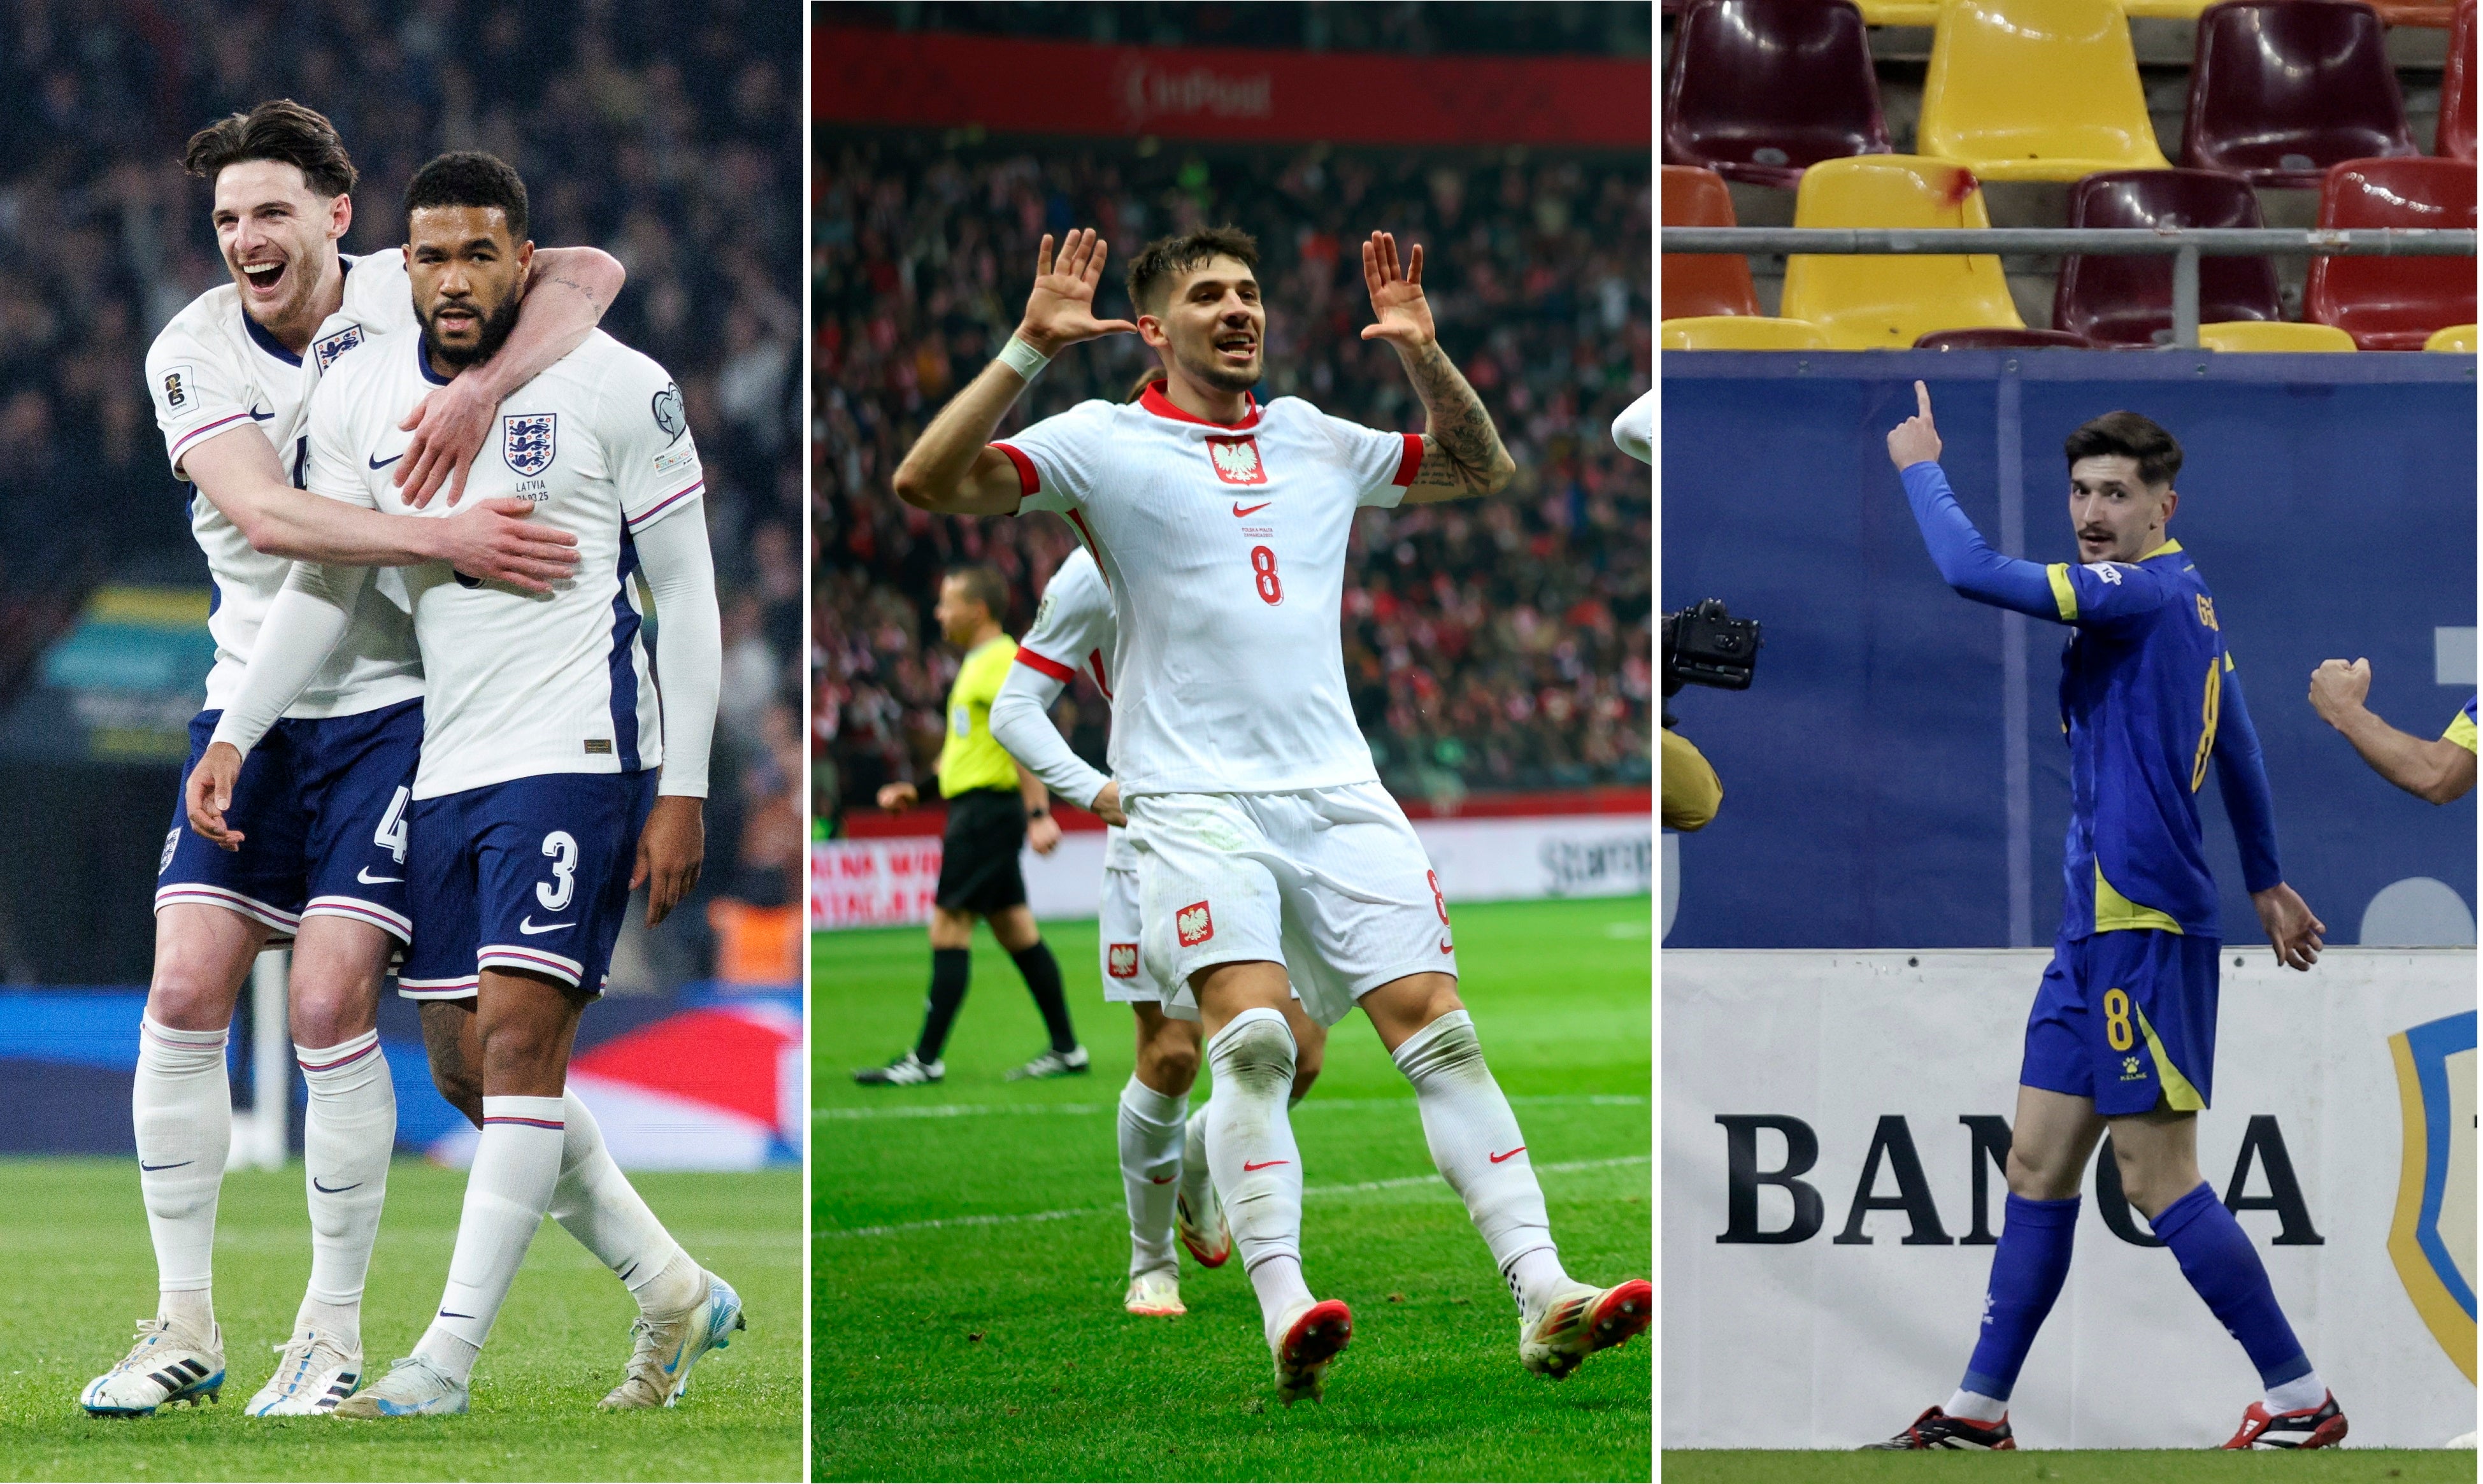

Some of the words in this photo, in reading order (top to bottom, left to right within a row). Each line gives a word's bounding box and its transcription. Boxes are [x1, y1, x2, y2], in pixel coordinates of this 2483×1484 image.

[516, 480, 545, 492] LATVIA
[517, 491, 548, 502] 403.25
[1251, 545, 1284, 606] 8
[374, 785, 410, 865] 4
[536, 830, 578, 911] 3
[2104, 987, 2134, 1052] 8
